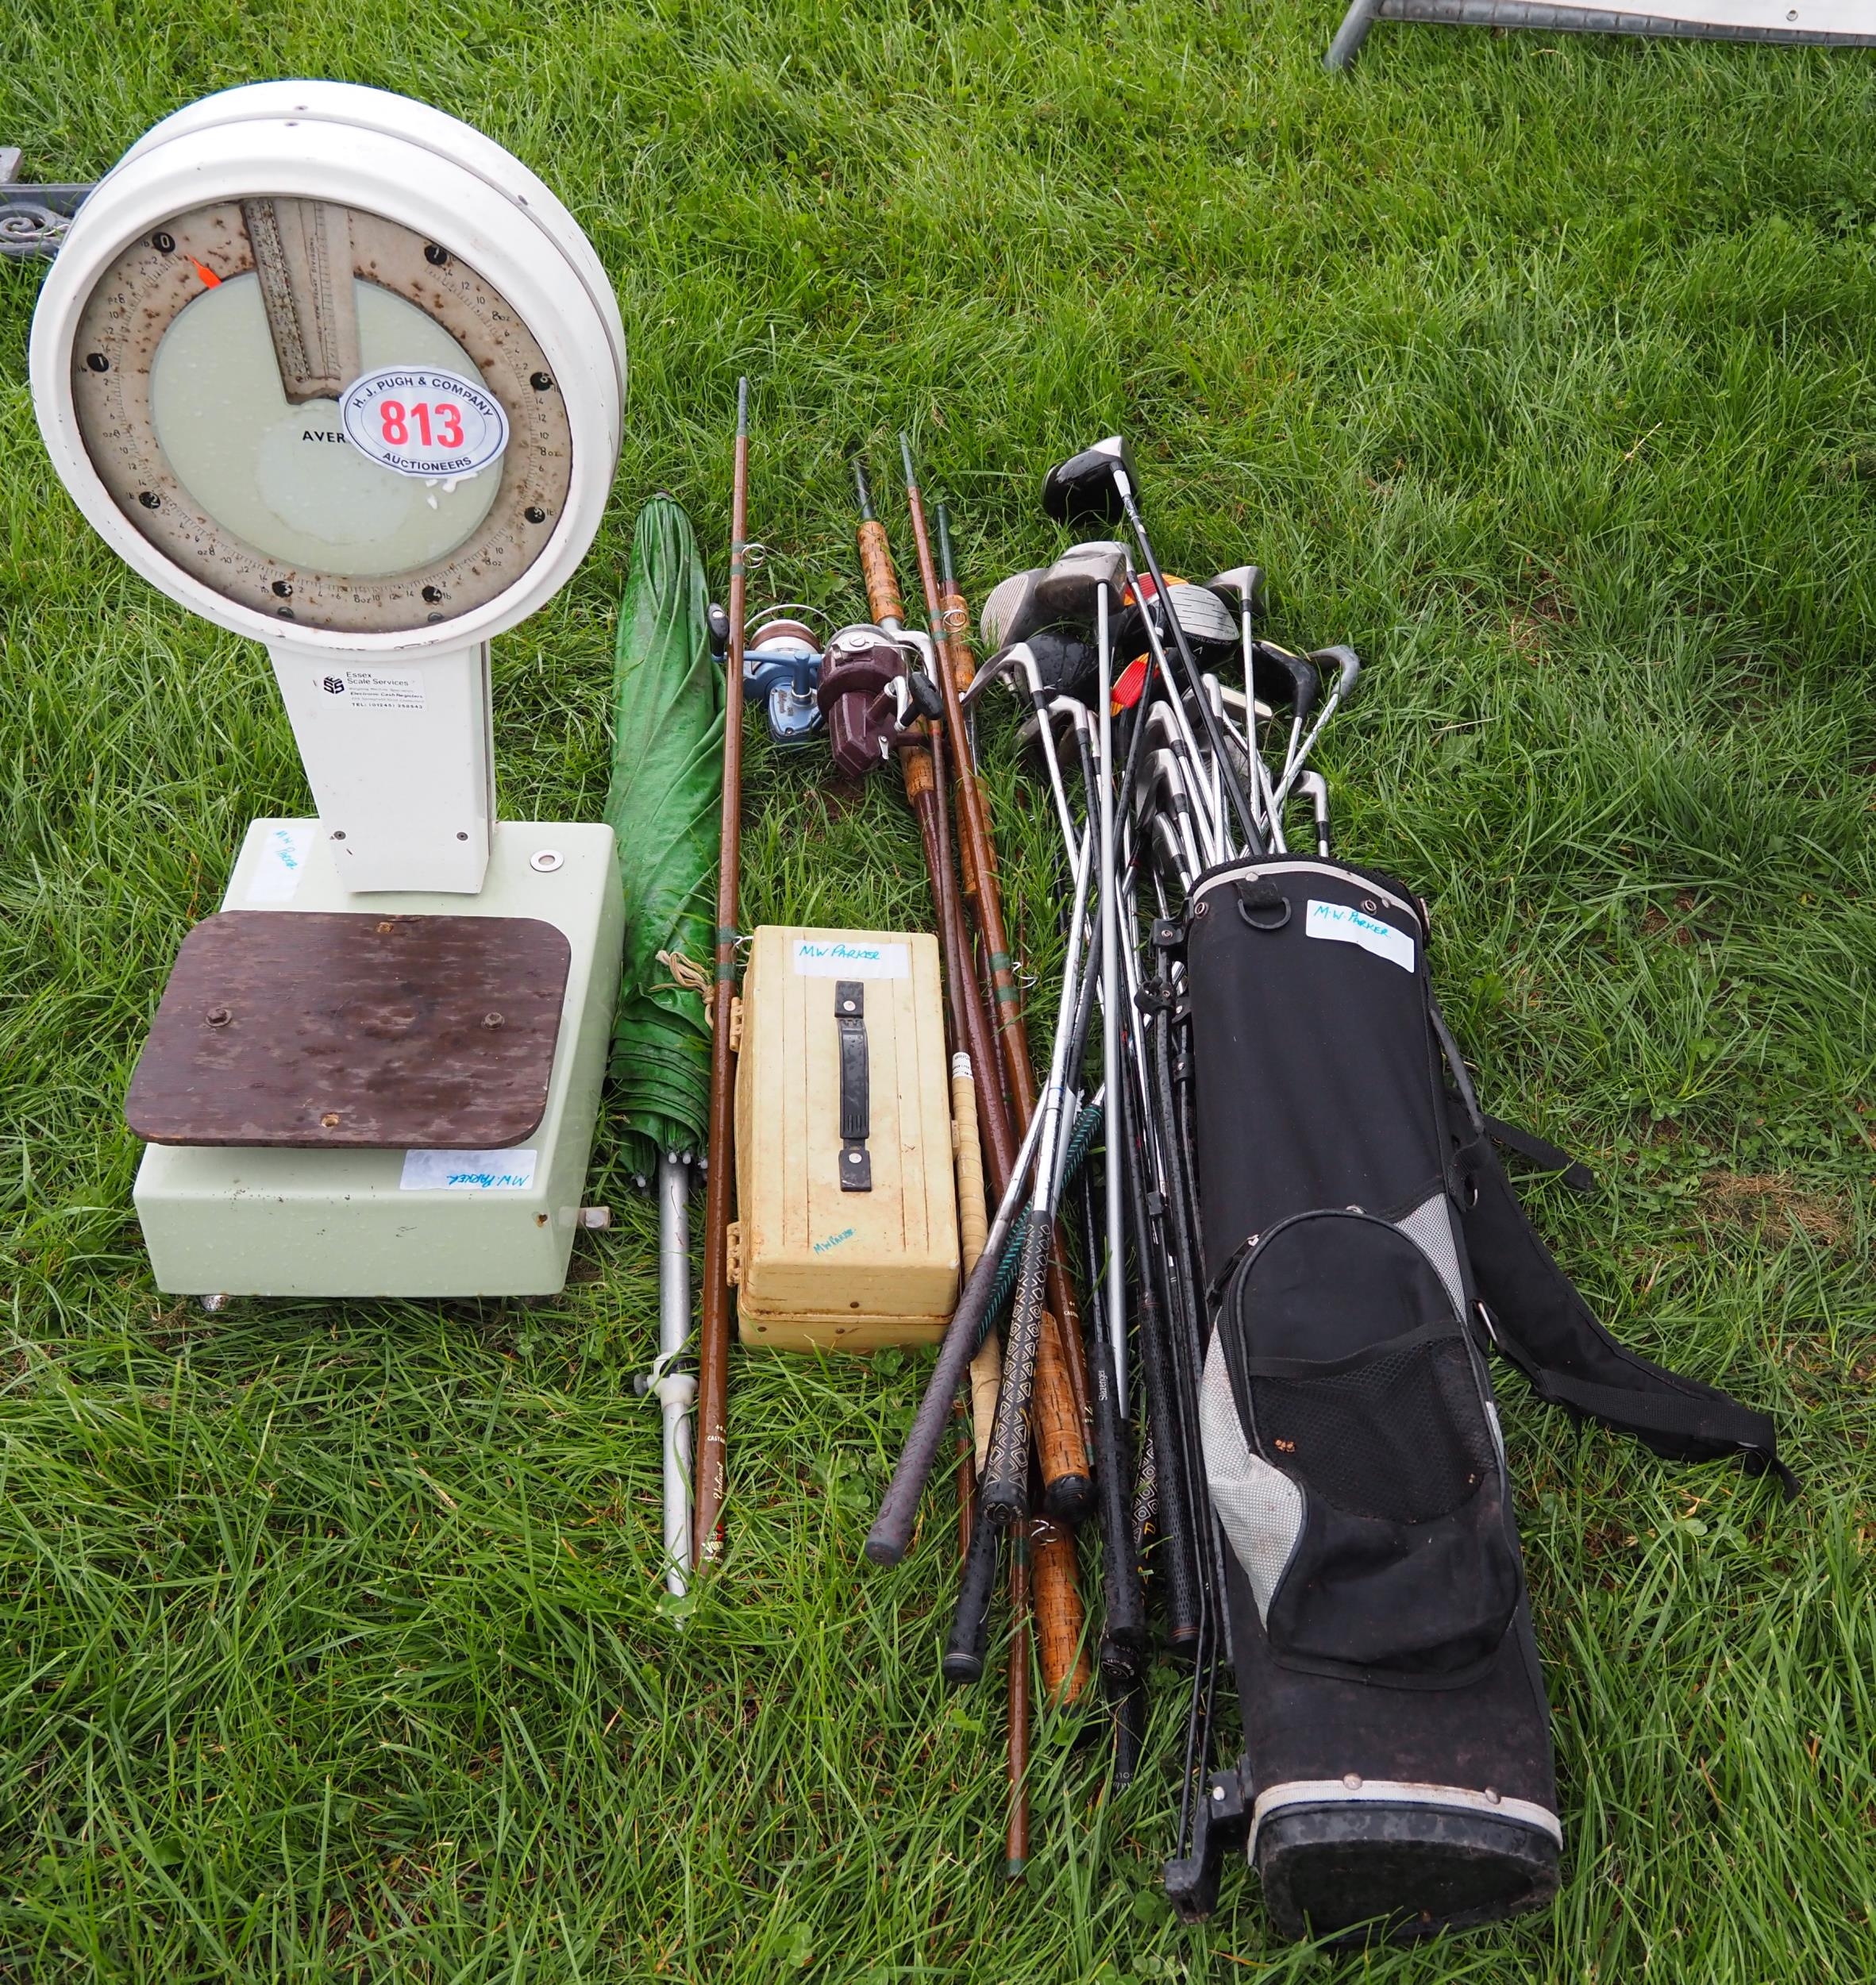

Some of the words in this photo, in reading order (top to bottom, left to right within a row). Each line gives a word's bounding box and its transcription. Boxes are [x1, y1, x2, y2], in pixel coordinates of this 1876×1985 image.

[160, 235, 171, 249] 0
[461, 280, 470, 290] 12
[352, 396, 366, 409] H.
[378, 376, 414, 391] PUGH
[418, 377, 427, 386] &
[432, 378, 494, 418] COMPANY
[379, 399, 465, 449] 813
[538, 414, 548, 423] 12
[302, 430, 352, 445] AVER
[383, 453, 472, 471] AUCTIONEERS
[372, 593, 381, 602] 10
[830, 943, 881, 960] PARKER
[1098, 1368, 1109, 1401] Slazenger
[712, 1460, 725, 1501] Valiant
